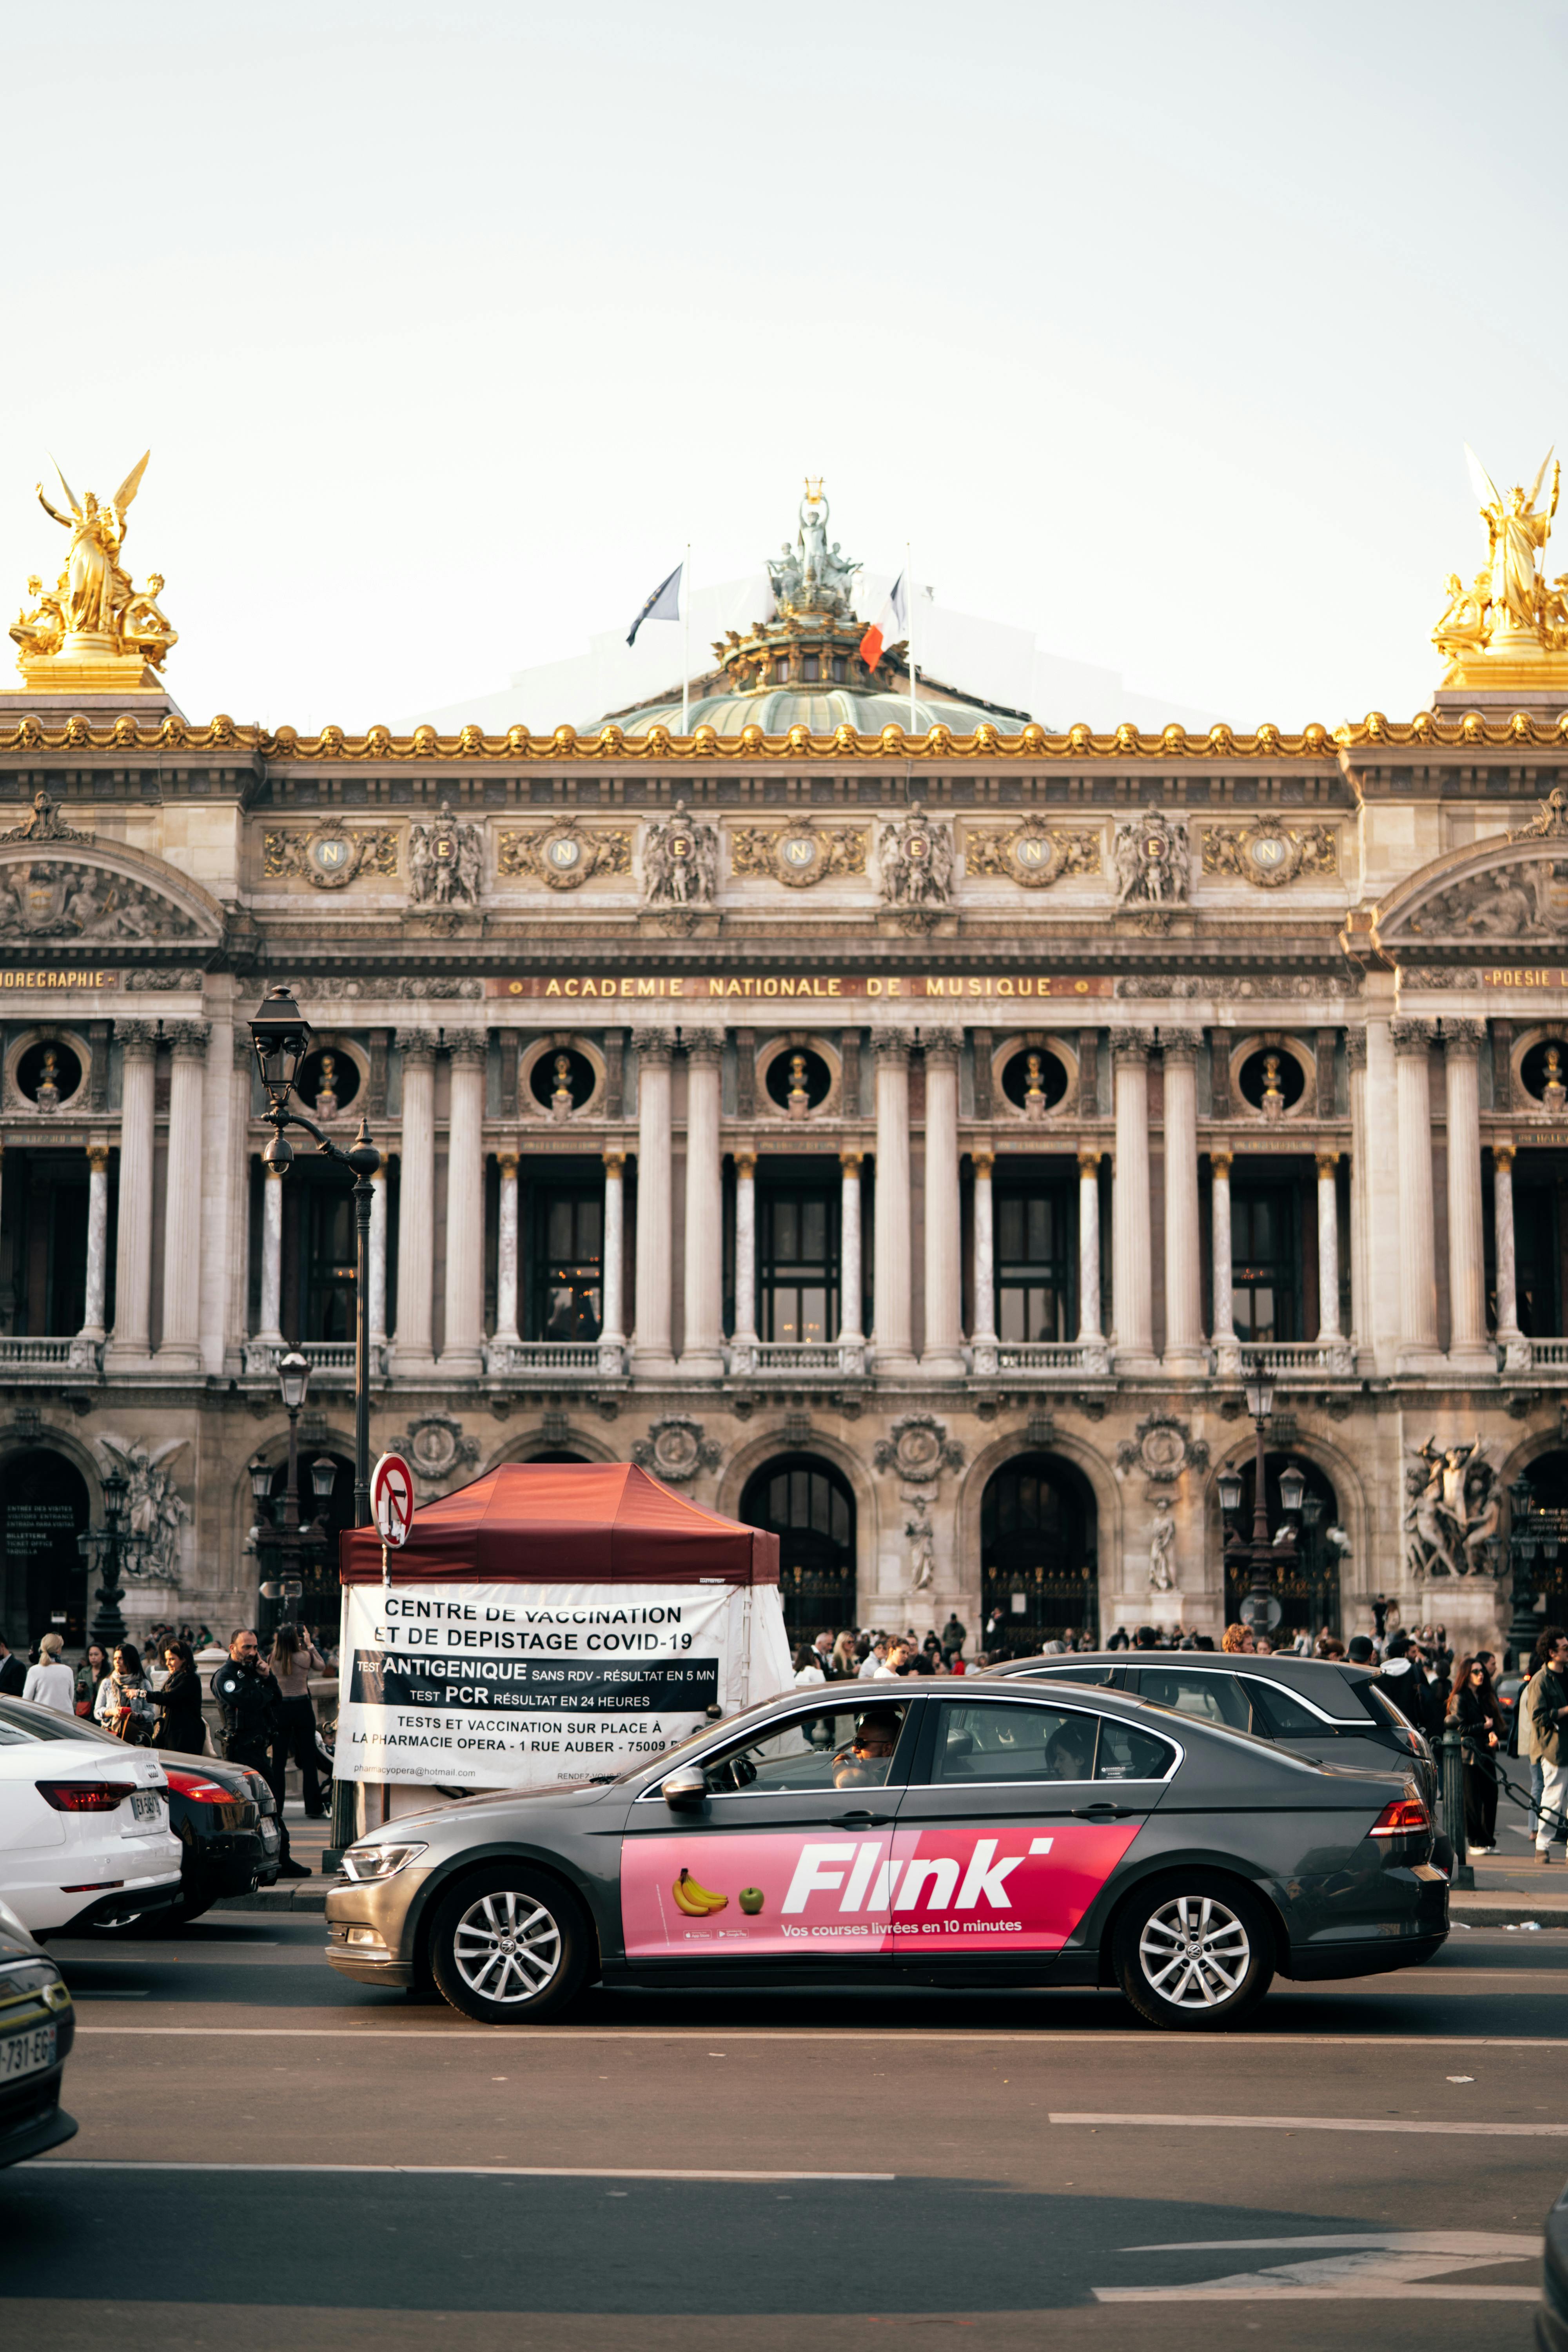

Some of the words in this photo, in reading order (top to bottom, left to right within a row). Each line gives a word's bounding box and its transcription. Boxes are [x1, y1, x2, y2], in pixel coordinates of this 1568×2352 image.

[323, 846, 337, 861] N
[438, 840, 450, 856] E
[557, 845, 572, 860] N
[674, 840, 686, 855] E
[792, 844, 806, 860] N
[911, 840, 922, 856] E
[1027, 844, 1041, 860] N
[1148, 840, 1160, 856] E
[1262, 844, 1276, 860] N
[0, 971, 104, 987] OREGRAPHIE
[1492, 969, 1550, 987] POESIE
[545, 978, 683, 996] ACADEMIE
[709, 978, 842, 996] NATIONALE
[867, 978, 901, 996] DE
[926, 977, 1051, 996] MUSIQUE
[385, 1599, 477, 1620] CENTRE
[486, 1607, 515, 1622] DE
[525, 1606, 681, 1624] VACCINATION
[375, 1626, 400, 1643] ET
[408, 1627, 439, 1645] DE
[448, 1629, 578, 1650] DEPISTAGE
[587, 1633, 692, 1650] COVID-19
[357, 1661, 380, 1673] TEST
[382, 1657, 527, 1681] ANTIGENIQUE
[532, 1670, 564, 1681] SANS
[568, 1671, 594, 1681] RDV
[603, 1669, 664, 1681] RÉSULTAT
[667, 1670, 683, 1681] EN
[686, 1670, 693, 1681] 5
[696, 1670, 715, 1680] MN
[410, 1690, 441, 1702] TEST
[445, 1686, 489, 1704] PCR
[494, 1692, 557, 1706] RÉSULTAT
[560, 1696, 578, 1706] EN
[581, 1696, 594, 1706] 24
[598, 1696, 650, 1707] HEURES
[397, 1715, 441, 1729] TESTS
[446, 1719, 463, 1730] ET
[468, 1720, 562, 1733] VACCINATION
[567, 1723, 596, 1733] SUR
[601, 1723, 647, 1733] PLACE
[652, 1720, 662, 1733] À
[352, 1732, 368, 1744] LA
[372, 1733, 452, 1748] PHARMACIE
[457, 1738, 506, 1750] OPERA
[519, 1741, 525, 1751] 1
[531, 1741, 560, 1751] RUE
[564, 1741, 614, 1752] AUBER
[628, 1740, 666, 1751] 75009
[354, 1764, 475, 1777] pharmacyopera@hotmail.com
[781, 1839, 1026, 1913] Flink
[781, 1924, 808, 1936] Vos
[811, 1923, 868, 1935] courses
[871, 1921, 919, 1934] livrées
[922, 1922, 940, 1933] en
[944, 1920, 960, 1933] 10
[963, 1919, 1022, 1932] minutes
